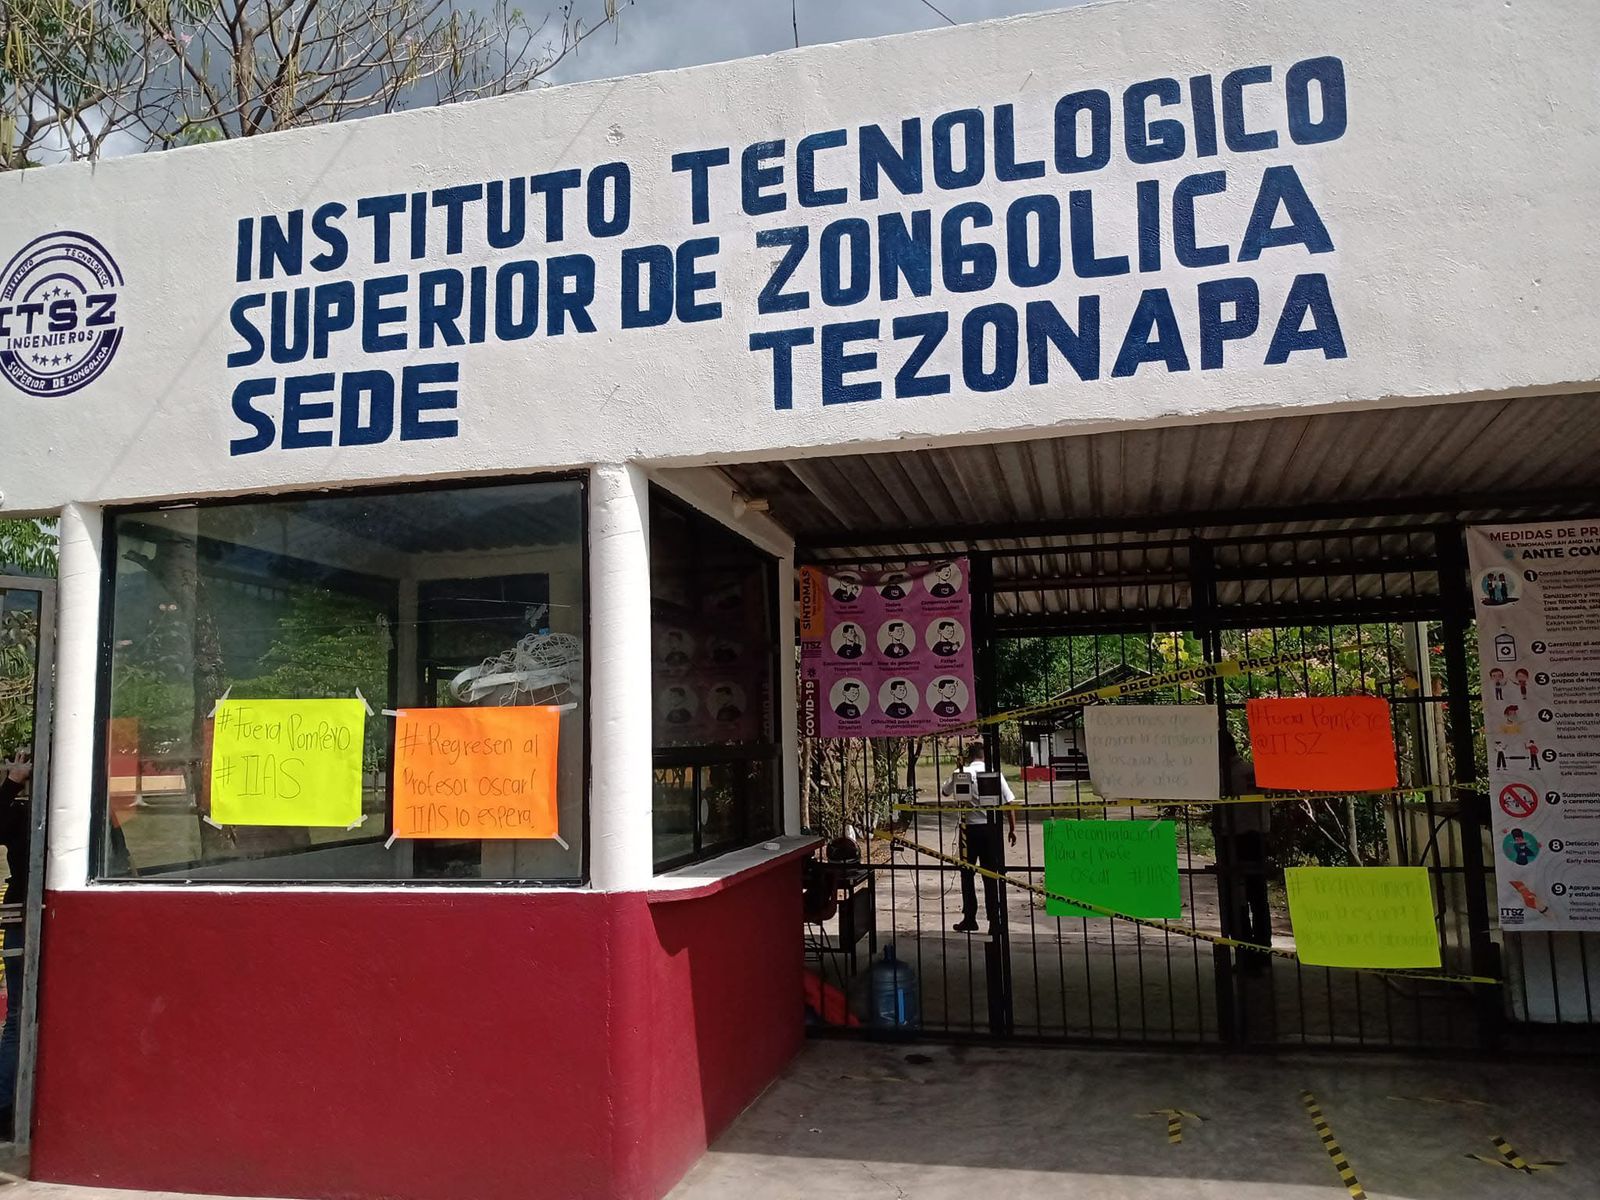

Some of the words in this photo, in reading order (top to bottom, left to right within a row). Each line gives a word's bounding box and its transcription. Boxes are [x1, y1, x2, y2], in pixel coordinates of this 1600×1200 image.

[237, 162, 630, 281] INSTITUTO
[672, 57, 1347, 224] TECNOLOGICO
[64, 248, 109, 287] TECNOLOGICO
[228, 254, 597, 368] SUPERIOR
[621, 237, 722, 328] DE
[757, 166, 1334, 314] ZONGOLICA
[7, 330, 94, 350] INGENIEROS
[8, 361, 46, 390] SUPERIOR
[53, 378, 65, 388] DE
[67, 346, 109, 384] ZONGOLICA
[231, 362, 458, 456] SEDE
[749, 274, 1347, 410] TEZONAPA
[1490, 528, 1553, 542] MEDIDAS
[1557, 528, 1576, 538] DE
[1580, 526, 1600, 537] PR
[1522, 547, 1564, 560] ANTE
[217, 706, 282, 745] #Fuera
[805, 681, 815, 737] COVID-19
[523, 734, 538, 757] al
[403, 767, 467, 797] Profesor
[1501, 907, 1524, 916] ITSZ
